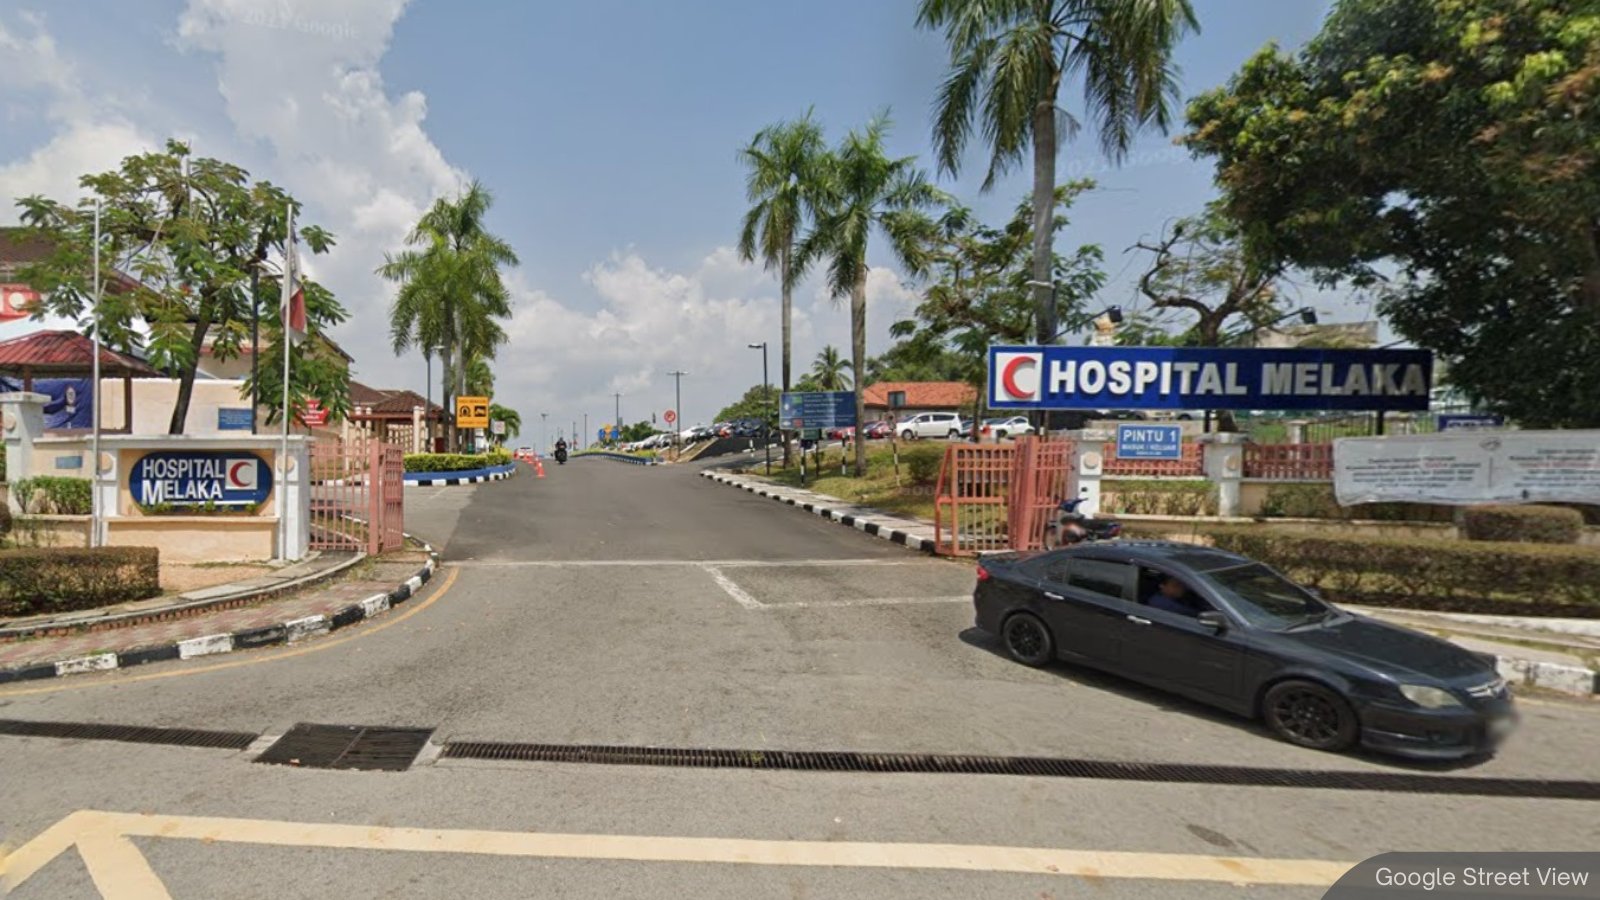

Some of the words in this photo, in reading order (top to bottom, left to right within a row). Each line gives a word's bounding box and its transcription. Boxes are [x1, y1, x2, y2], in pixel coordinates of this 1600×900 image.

[1048, 359, 1248, 397] HOSPITAL
[1259, 362, 1427, 397] MELAKA
[1123, 429, 1164, 442] PINTU
[1169, 430, 1177, 443] 1
[141, 458, 225, 479] HOSPITAL
[141, 479, 224, 506] MELAKA
